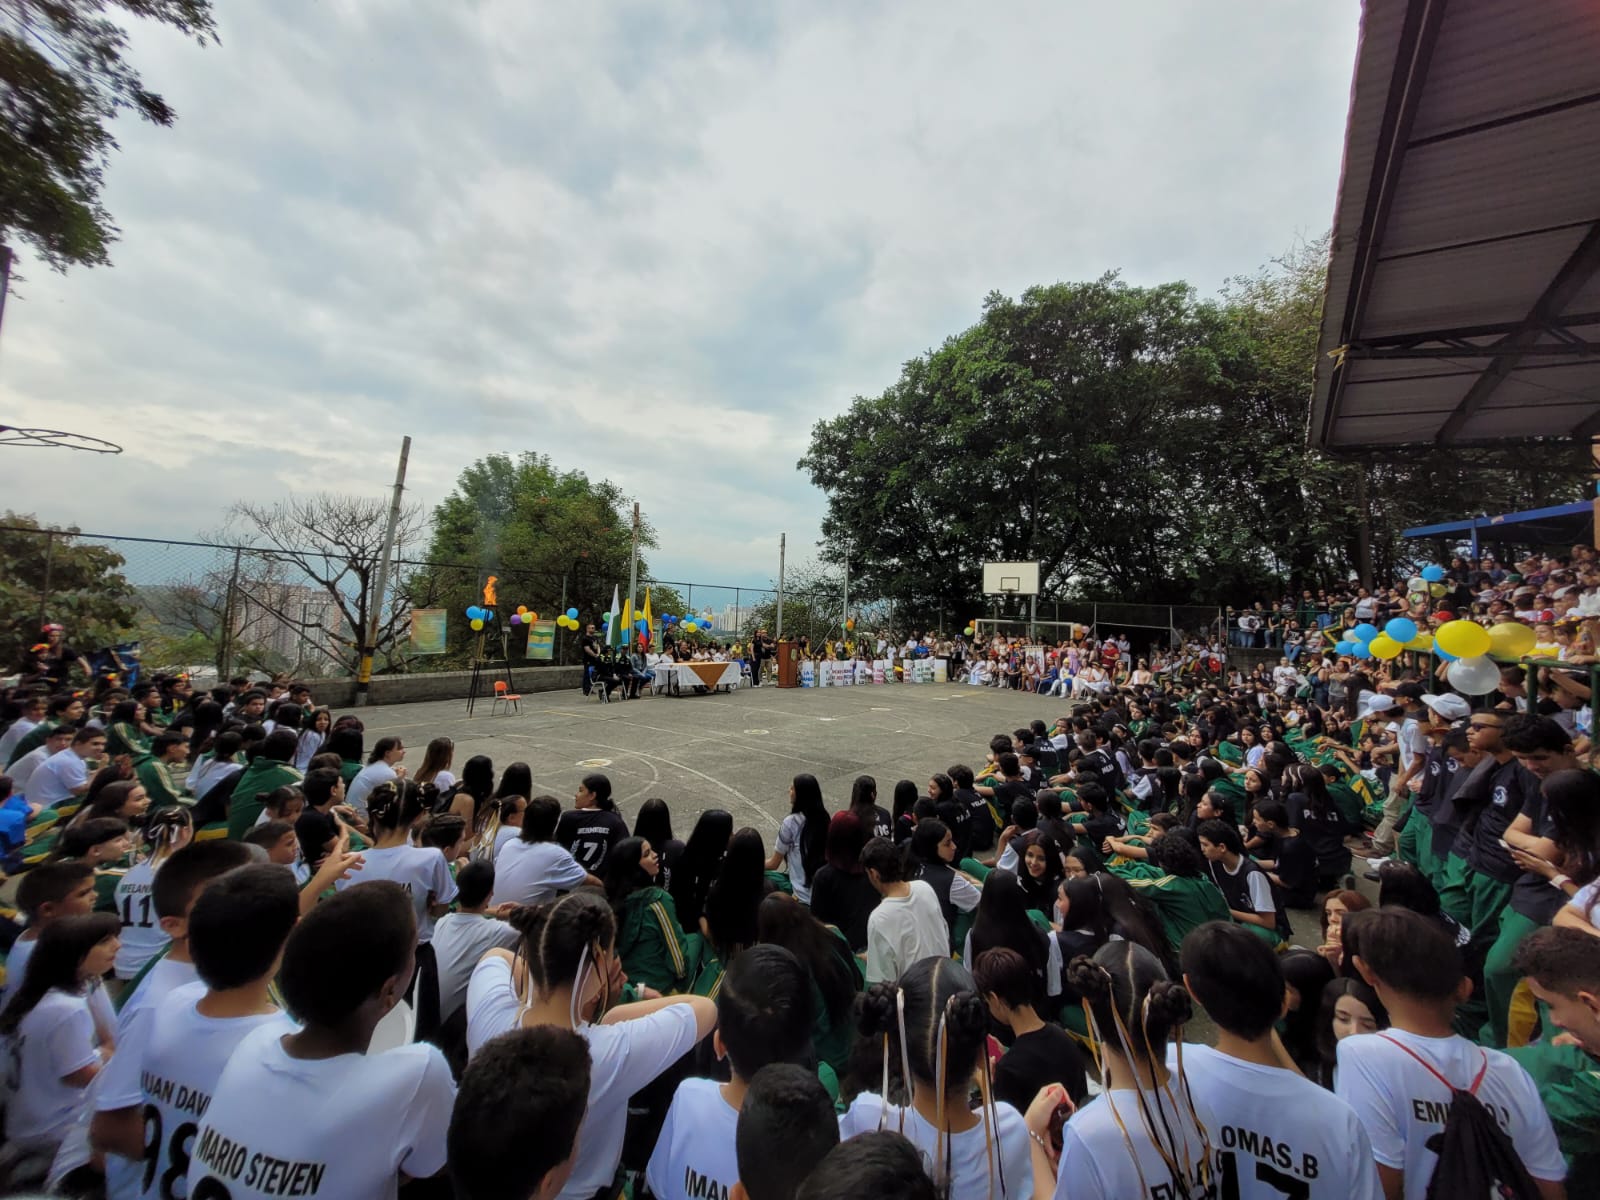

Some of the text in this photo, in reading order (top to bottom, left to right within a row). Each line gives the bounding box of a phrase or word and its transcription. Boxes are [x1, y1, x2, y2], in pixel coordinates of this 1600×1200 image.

[583, 842, 598, 861] 7
[120, 883, 153, 894] MELAN
[120, 894, 154, 928] 11
[175, 1085, 212, 1117] DAVI
[197, 1125, 247, 1180] MARIO
[245, 1152, 326, 1196] STEVEN
